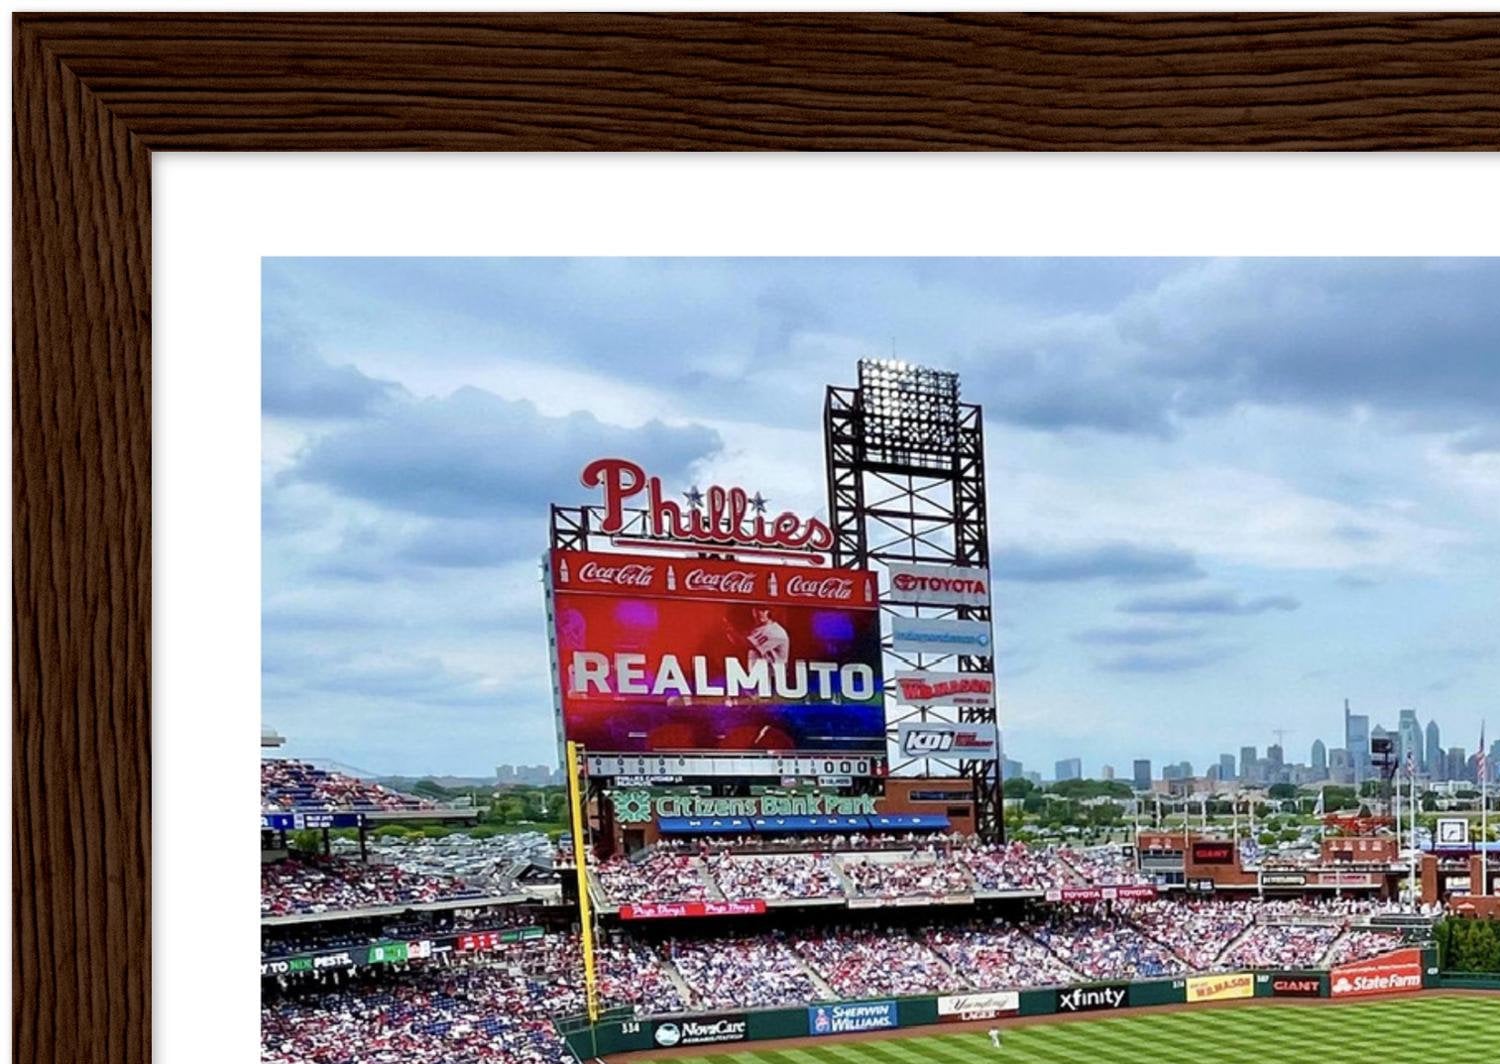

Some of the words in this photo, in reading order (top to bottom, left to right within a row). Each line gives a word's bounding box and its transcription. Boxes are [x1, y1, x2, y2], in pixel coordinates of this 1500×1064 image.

[580, 459, 834, 550] Phillies
[579, 561, 656, 586] Coca-Cola
[685, 568, 757, 593] Coca-Cola
[786, 575, 854, 600] Coca-Cola
[916, 576, 986, 595] TOYOTA
[572, 651, 875, 700] REALMUTO
[824, 761, 834, 773] 0
[840, 761, 851, 774] 0
[856, 761, 867, 774] 0
[656, 794, 757, 818] Citizens
[761, 793, 823, 817] Bank
[825, 793, 878, 816] Park
[1064, 889, 1100, 899] TOYOTA
[1119, 888, 1153, 897] TOYOTA
[271, 961, 288, 973] TO
[1273, 980, 1319, 992] GIANT
[1060, 987, 1126, 1011] xfinity
[832, 1006, 890, 1019] SHERWIN
[681, 1020, 746, 1037] NovaCare
